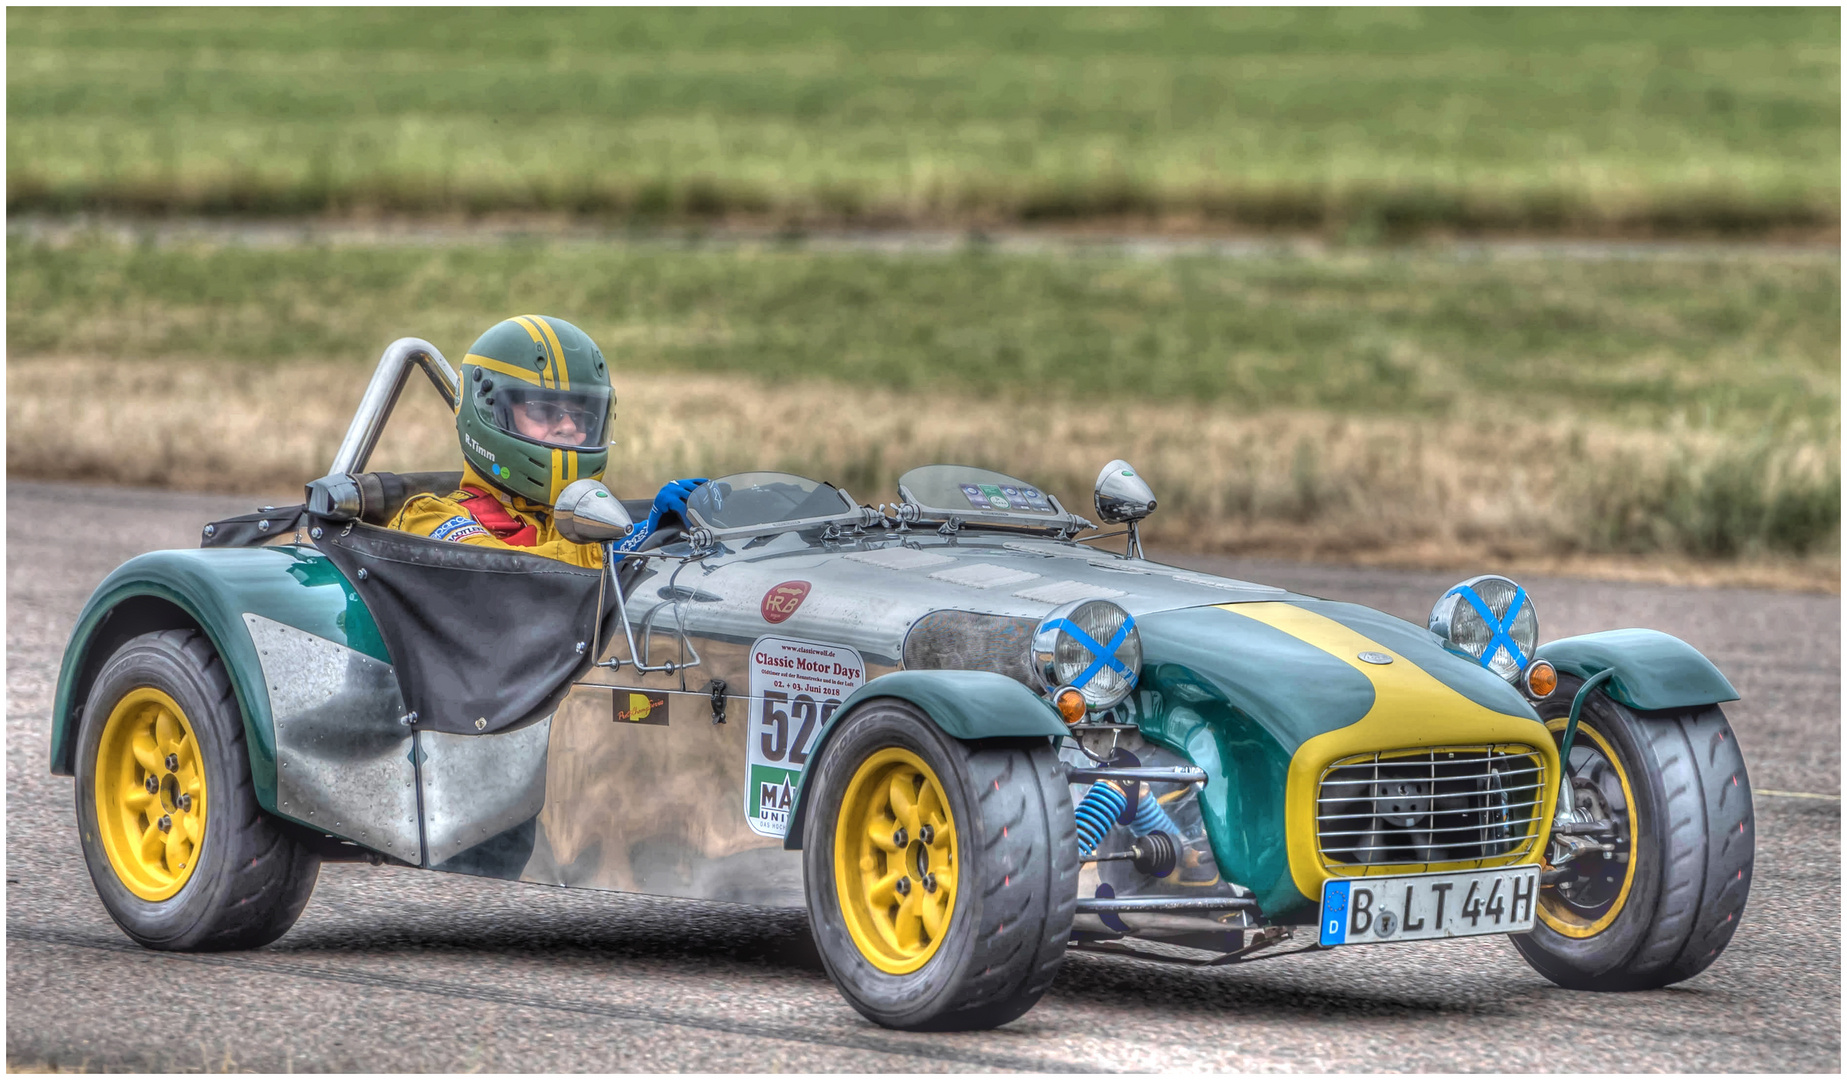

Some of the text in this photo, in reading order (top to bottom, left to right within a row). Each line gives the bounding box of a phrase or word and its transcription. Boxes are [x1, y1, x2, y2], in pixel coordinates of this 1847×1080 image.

[465, 432, 496, 462] R.Timm
[765, 594, 799, 614] HRB
[755, 652, 861, 680] Classic Motor Days
[761, 669, 780, 677] Oldtimer
[773, 680, 784, 688] 02.
[792, 684, 803, 692] 03.
[805, 683, 822, 694] Juni
[823, 687, 840, 696] 2018
[761, 777, 797, 809] MA
[1350, 888, 1374, 935] B
[1329, 920, 1339, 934] D
